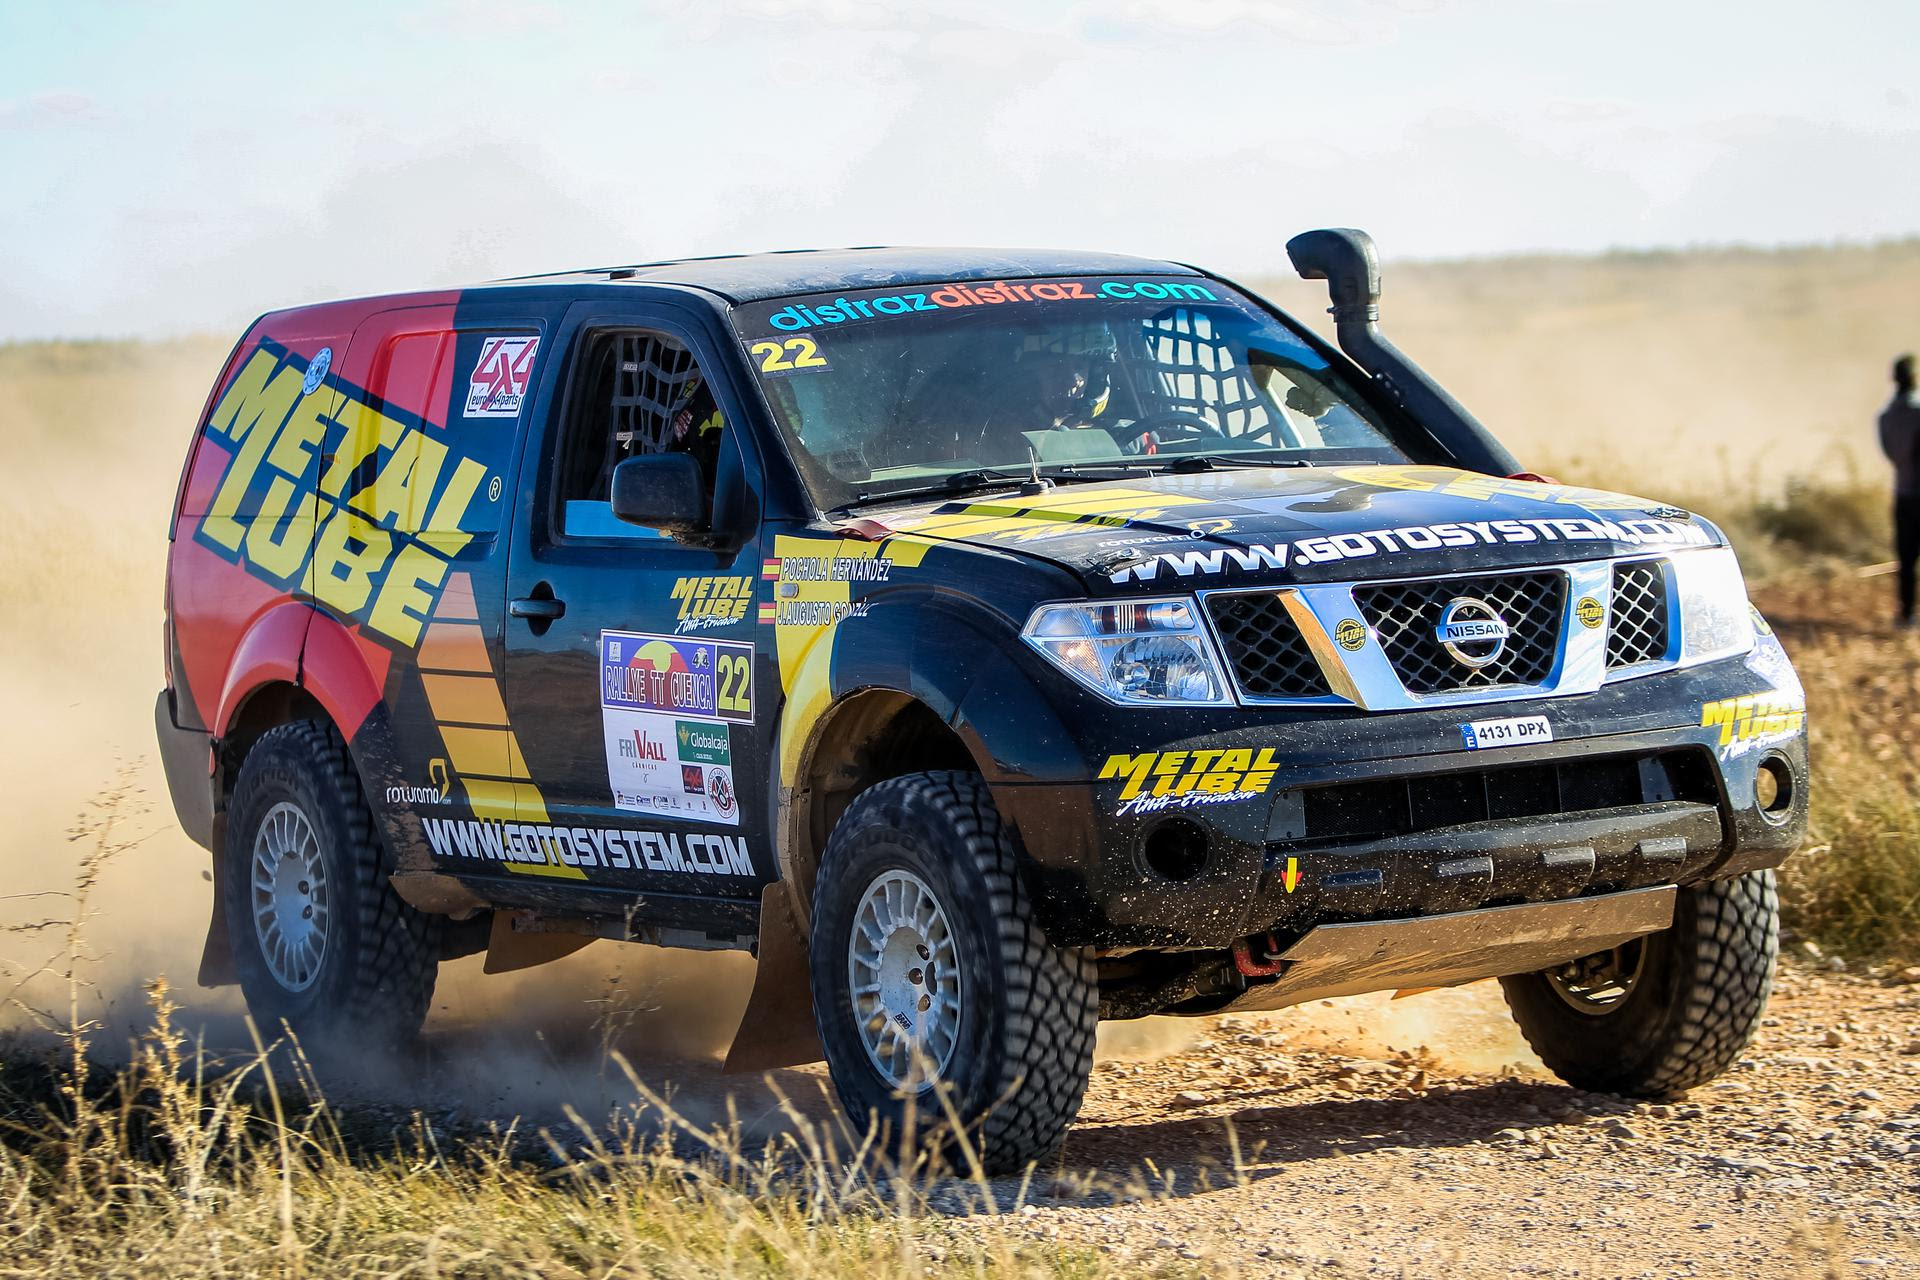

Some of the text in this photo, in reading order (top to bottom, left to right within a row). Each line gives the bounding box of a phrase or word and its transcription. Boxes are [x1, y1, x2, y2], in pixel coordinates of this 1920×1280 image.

[769, 281, 1217, 331] disfrazdisfraz.com
[752, 338, 827, 373] 22
[209, 348, 488, 558] METAL
[202, 471, 450, 648] LUBE
[782, 551, 893, 581] POCHOLA HERNÁNDEZ
[670, 575, 753, 600] METAL
[677, 598, 750, 620] LUBE
[777, 601, 831, 626] J.AUGUSTO
[1446, 624, 1505, 639] NISSAN
[605, 665, 712, 710] RALLYE TT CUENCA
[717, 654, 751, 713] 22
[690, 732, 728, 755] Globalcaja
[1467, 736, 1476, 747] E
[1479, 722, 1547, 740] 4131 DPX
[1098, 748, 1280, 779] METAL
[1119, 771, 1276, 801] LUBE
[422, 817, 756, 877] WWW.GOTOSYSTEM.COM
